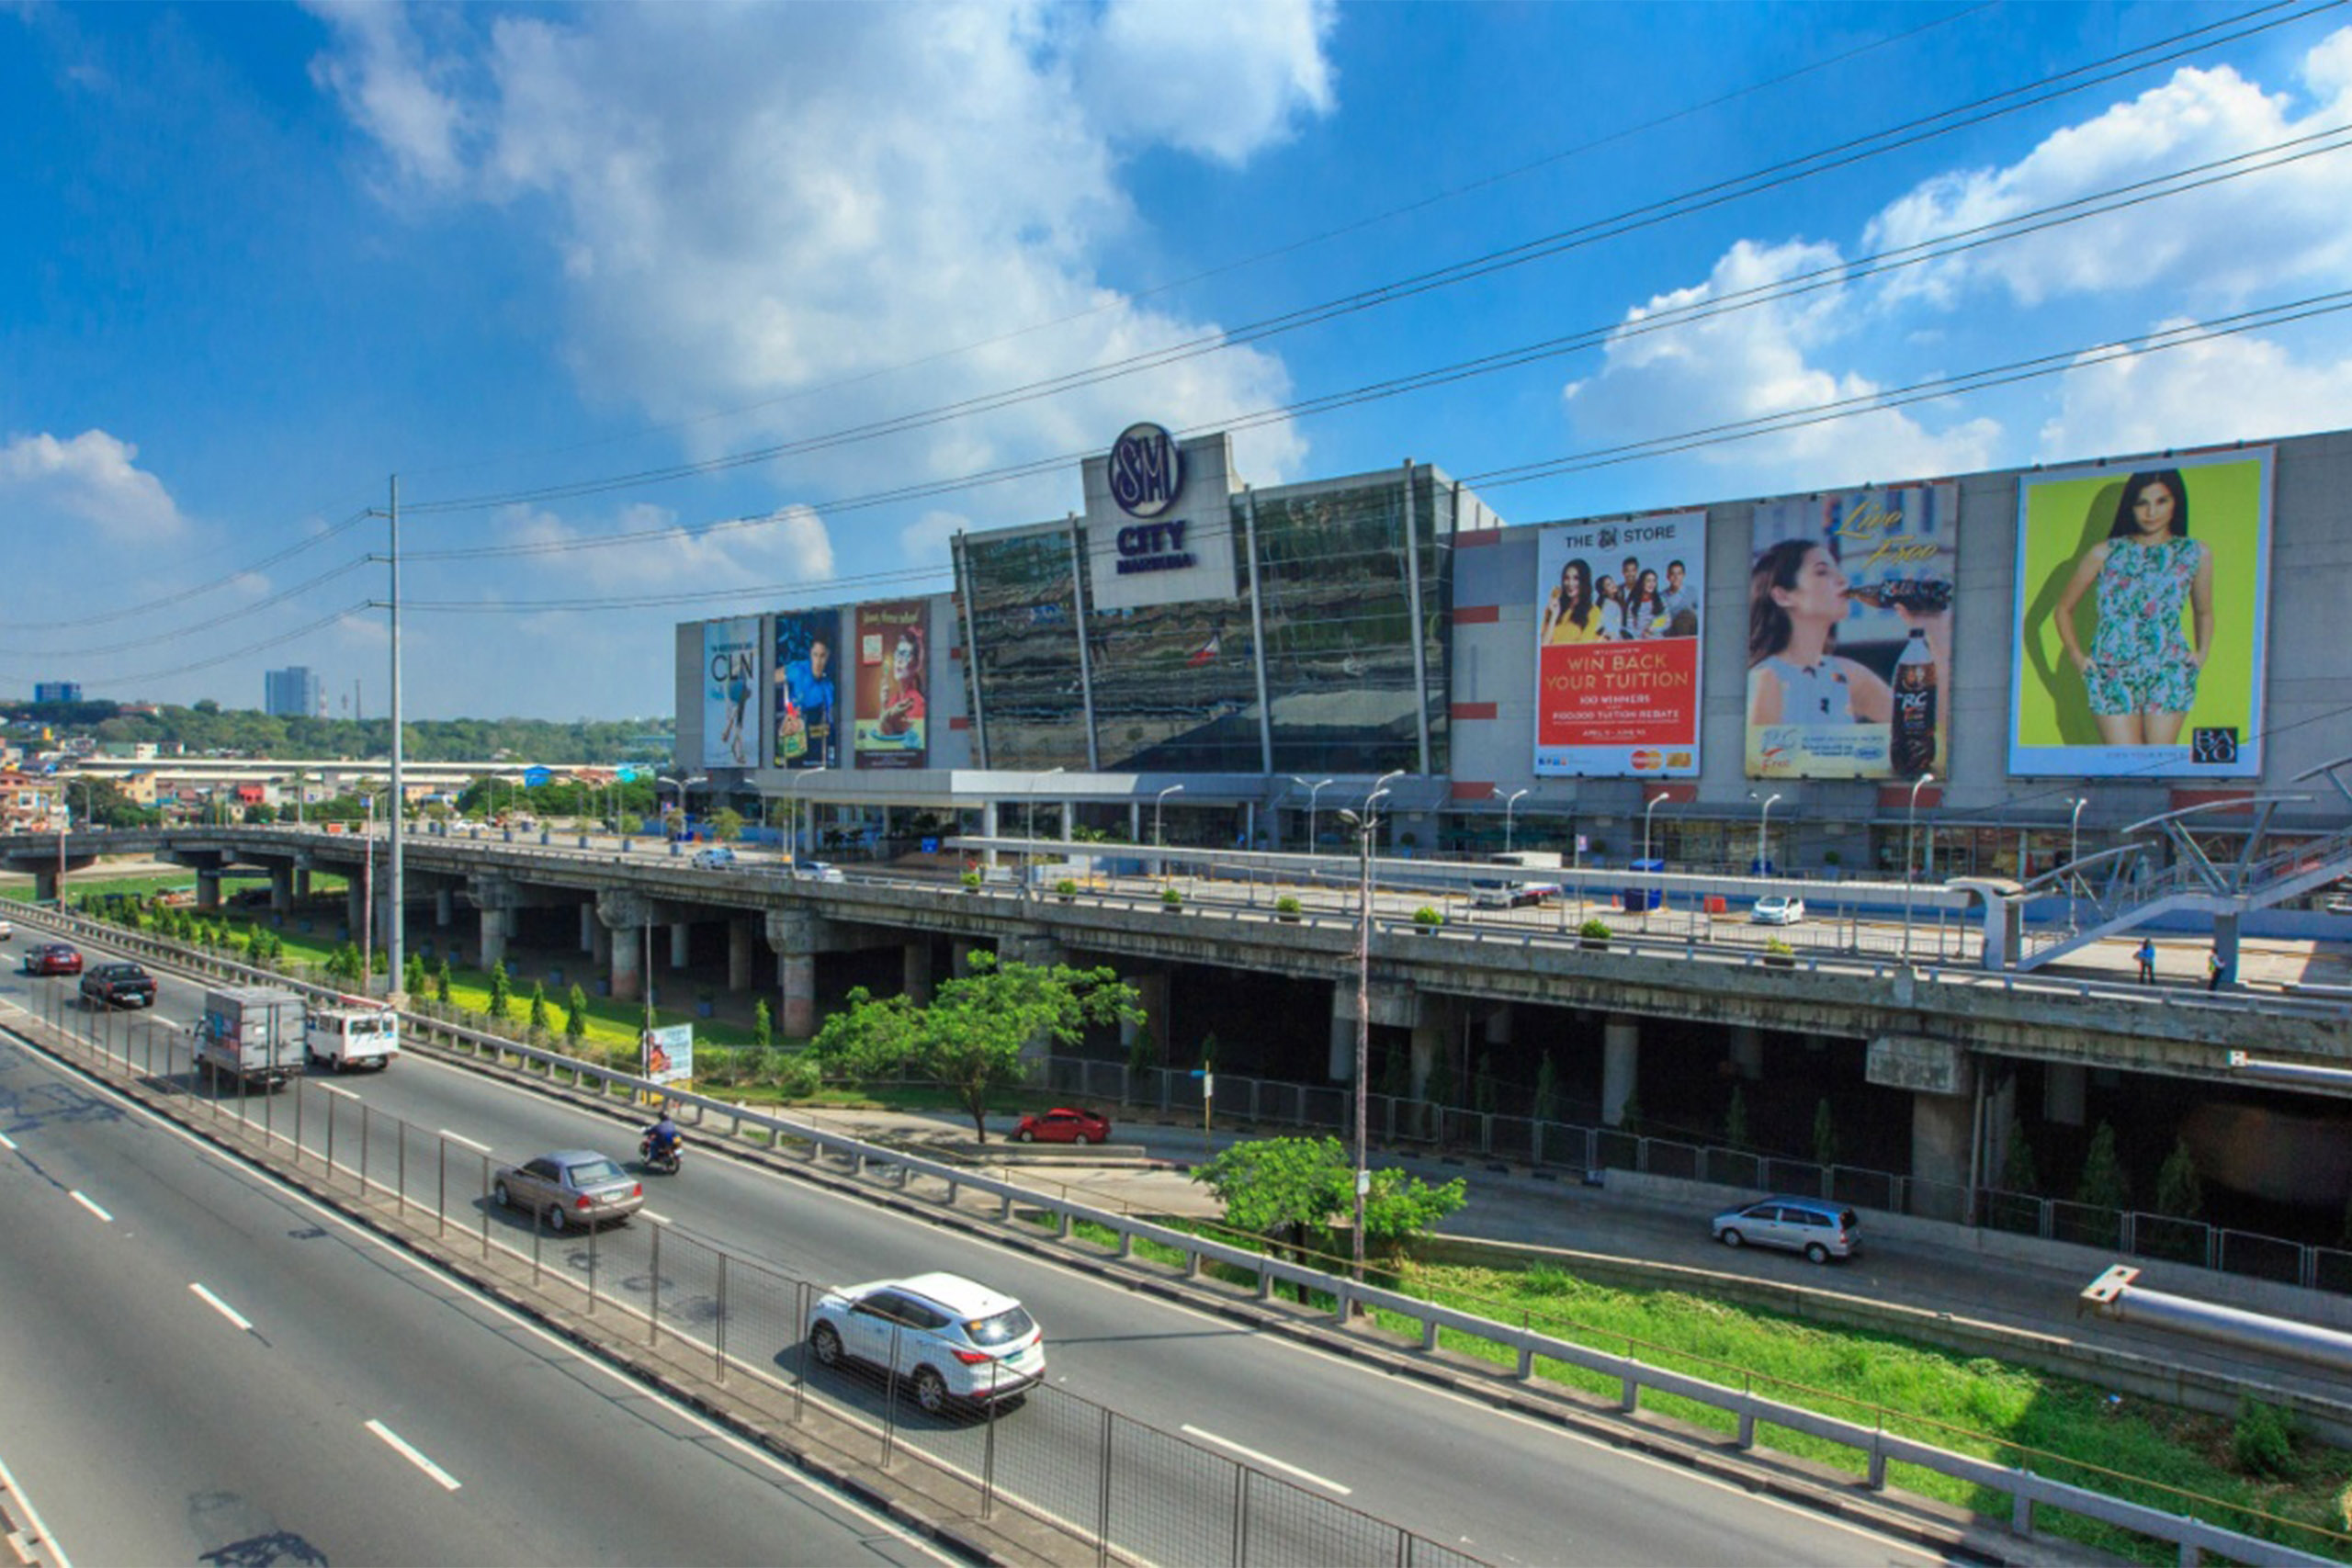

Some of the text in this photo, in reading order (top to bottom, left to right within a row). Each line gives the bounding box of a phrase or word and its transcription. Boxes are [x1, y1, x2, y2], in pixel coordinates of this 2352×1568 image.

[1114, 434, 1172, 509] SM
[1835, 501, 1902, 540] Live
[1116, 520, 1187, 557] CITY
[1565, 534, 1593, 548] THE
[1623, 525, 1676, 544] STORE
[1861, 535, 1938, 569] Free
[710, 651, 753, 682] CLN
[1566, 653, 1668, 671] WIN BACK
[1545, 671, 1689, 691] YOUR TUITION
[1600, 694, 1650, 705] WINNERS
[1598, 710, 1637, 720] TUITION
[1639, 708, 1679, 718] REBATE
